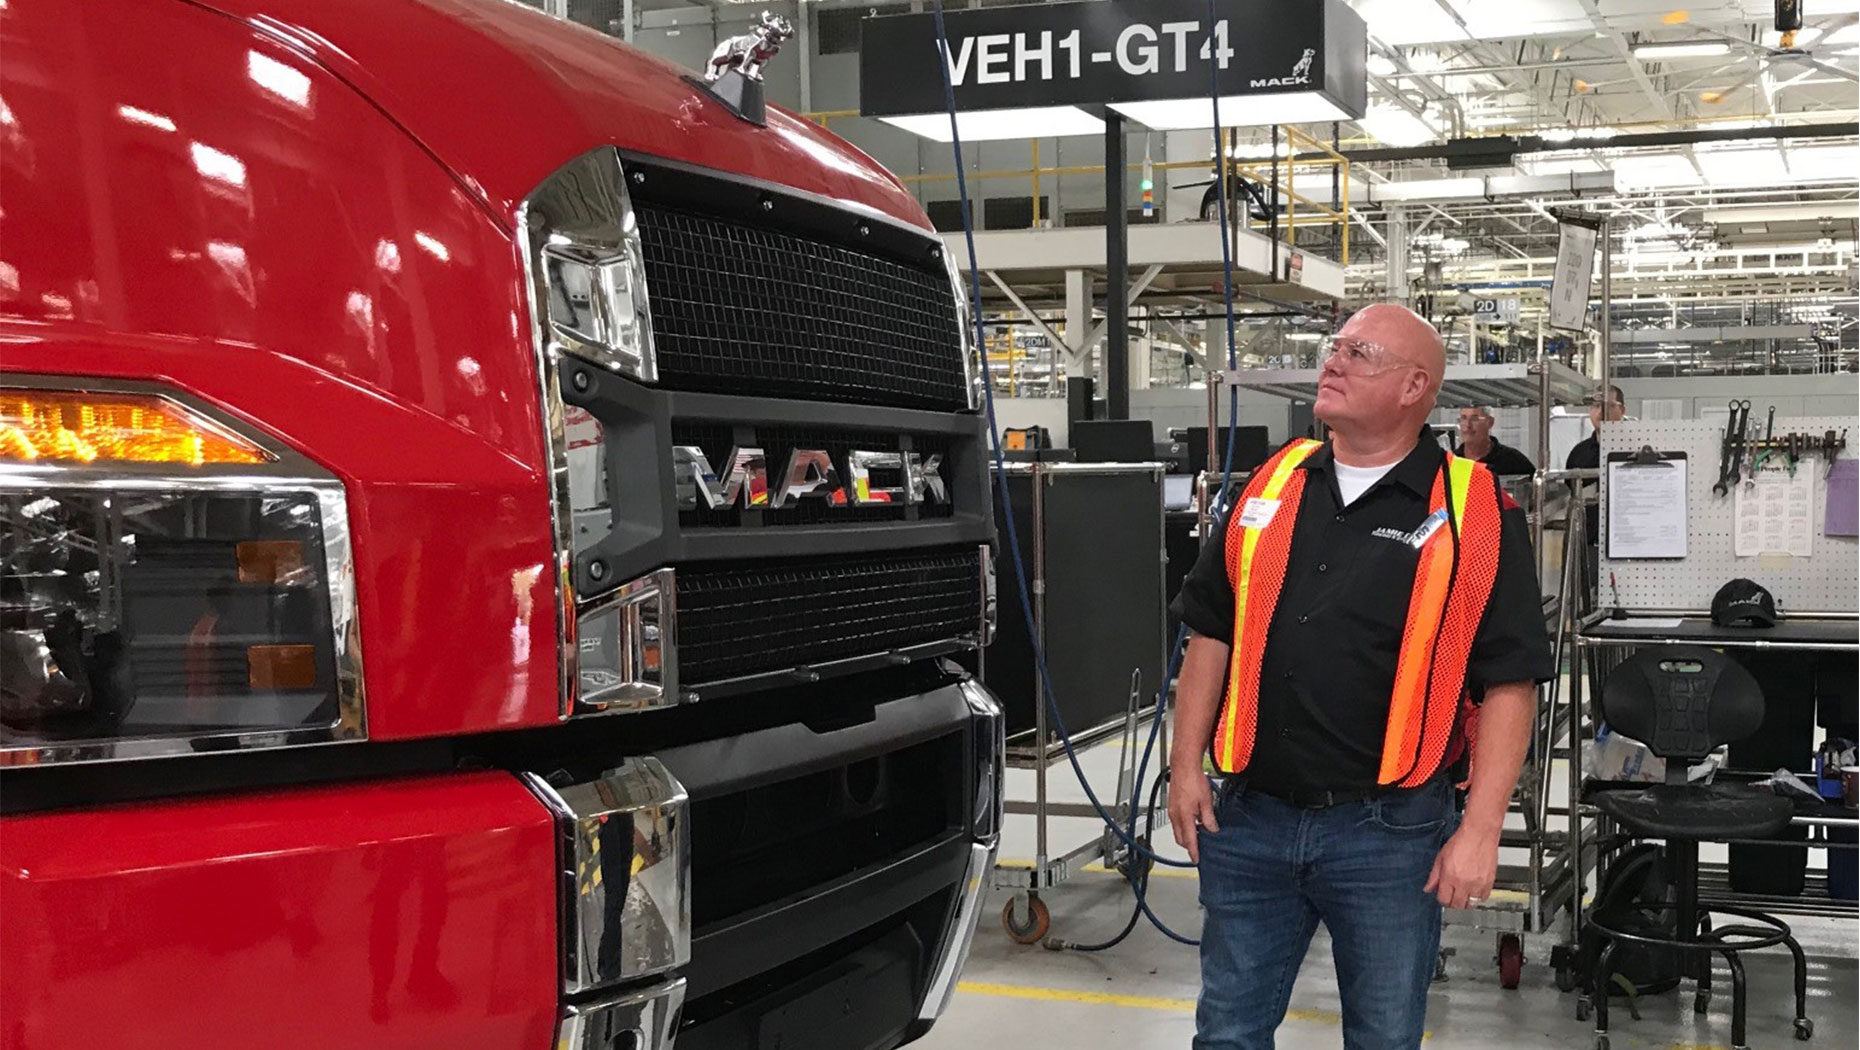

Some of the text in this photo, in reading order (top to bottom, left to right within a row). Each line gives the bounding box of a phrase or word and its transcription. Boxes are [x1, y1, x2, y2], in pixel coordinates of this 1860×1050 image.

[936, 20, 1234, 86] VEH1-GT4
[1250, 75, 1309, 88] MACK
[1477, 299, 1516, 312] 2D 18
[672, 445, 949, 510] MACK
